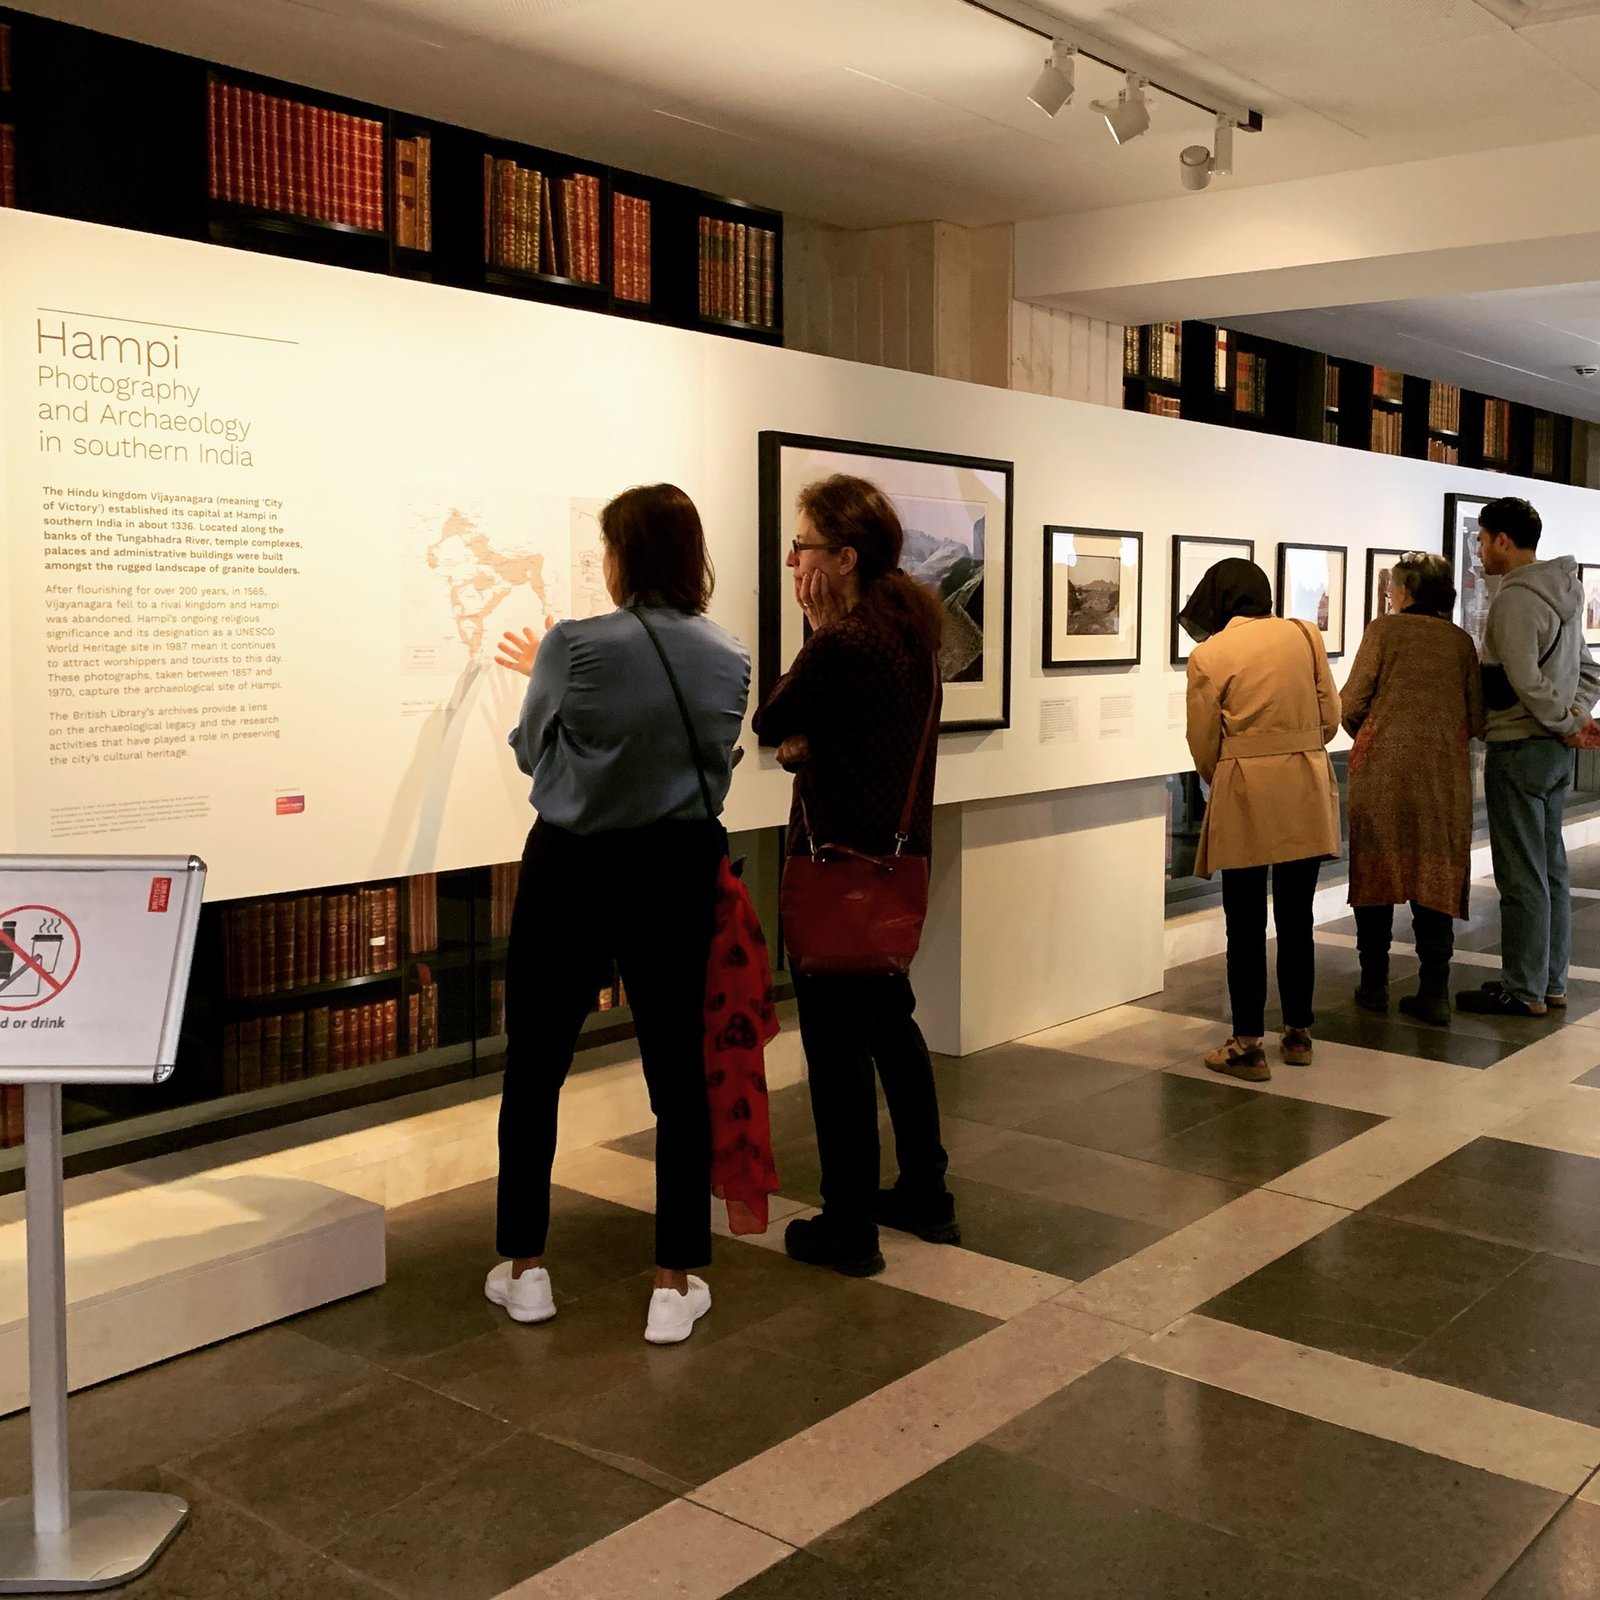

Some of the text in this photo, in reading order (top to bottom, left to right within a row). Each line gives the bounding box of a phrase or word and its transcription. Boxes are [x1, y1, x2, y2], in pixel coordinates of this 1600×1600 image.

[37, 318, 178, 377] Hampi
[38, 366, 200, 408] Photography
[38, 400, 252, 442] and Archaeology
[40, 429, 254, 467] in southern India
[42, 486, 64, 496] The
[67, 488, 99, 498] Hindu
[102, 489, 147, 502] kingdom
[150, 492, 213, 506] Vijayanagara
[216, 496, 260, 508] (meaning
[42, 502, 55, 510] of
[108, 505, 168, 516] established
[171, 508, 184, 516] its
[187, 509, 221, 519] capital
[236, 510, 266, 522] Hampi
[269, 512, 278, 520] in
[43, 518, 93, 527] southern
[96, 518, 122, 528] India
[125, 519, 135, 528] in
[138, 520, 168, 530] about
[199, 523, 238, 532] Located
[241, 524, 267, 536] along
[268, 525, 284, 534] the
[44, 531, 303, 549] banks of the Tungabhadra River, temple complexes,
[44, 546, 87, 557] palaces
[90, 548, 110, 557] and
[113, 548, 187, 559] administrative
[190, 550, 233, 562] buildings
[262, 551, 283, 561] built
[44, 562, 301, 576] amongst the rugged landscape of granite boulders.
[45, 584, 267, 598] After flourishing for over 200 years, in 1565,
[45, 599, 113, 611] Vijayanagara
[116, 599, 133, 609] fell
[137, 600, 148, 609] to
[161, 600, 182, 609] rival
[185, 600, 226, 611] kingdom
[229, 601, 247, 609] and
[250, 601, 280, 610] Hampi
[45, 616, 68, 624] was
[72, 614, 133, 624] abandoned.
[180, 614, 218, 625] ongoing
[221, 614, 260, 625] religious
[46, 628, 110, 641] significance
[113, 628, 133, 638] and
[137, 629, 149, 638] its
[152, 628, 209, 639] designation
[212, 629, 224, 637] as
[235, 627, 275, 637] UNESCO
[46, 641, 276, 654] World Heritage site in 1987 mean it continues
[47, 660, 59, 668] to
[62, 658, 100, 668] attract
[103, 657, 167, 668] worshippers
[170, 656, 189, 665] and
[191, 656, 229, 665] tourists
[232, 656, 242, 664] to
[245, 654, 262, 663] this
[47, 667, 272, 684] These photographs, taken between 1857 and
[48, 687, 75, 698] 1970,
[78, 687, 120, 698] capture
[123, 685, 141, 695] the
[144, 682, 215, 694] archaeological
[218, 683, 235, 692] site
[238, 681, 248, 690] of
[49, 711, 69, 721] The
[73, 709, 107, 720] British
[158, 706, 199, 716] archives
[202, 704, 237, 716] provide
[248, 703, 268, 712] lens
[48, 716, 279, 736] on the archaeological legacy and the research
[49, 740, 98, 751] activities
[101, 738, 123, 748] that
[127, 737, 150, 746] have
[154, 734, 186, 746] played
[198, 732, 217, 742] role
[220, 730, 229, 740] in
[232, 729, 281, 741] preserving
[49, 756, 68, 766] the
[103, 751, 143, 762] cultural
[146, 749, 189, 759] heritage.
[13, 1019, 27, 1029] or
[31, 1016, 65, 1029] drink
